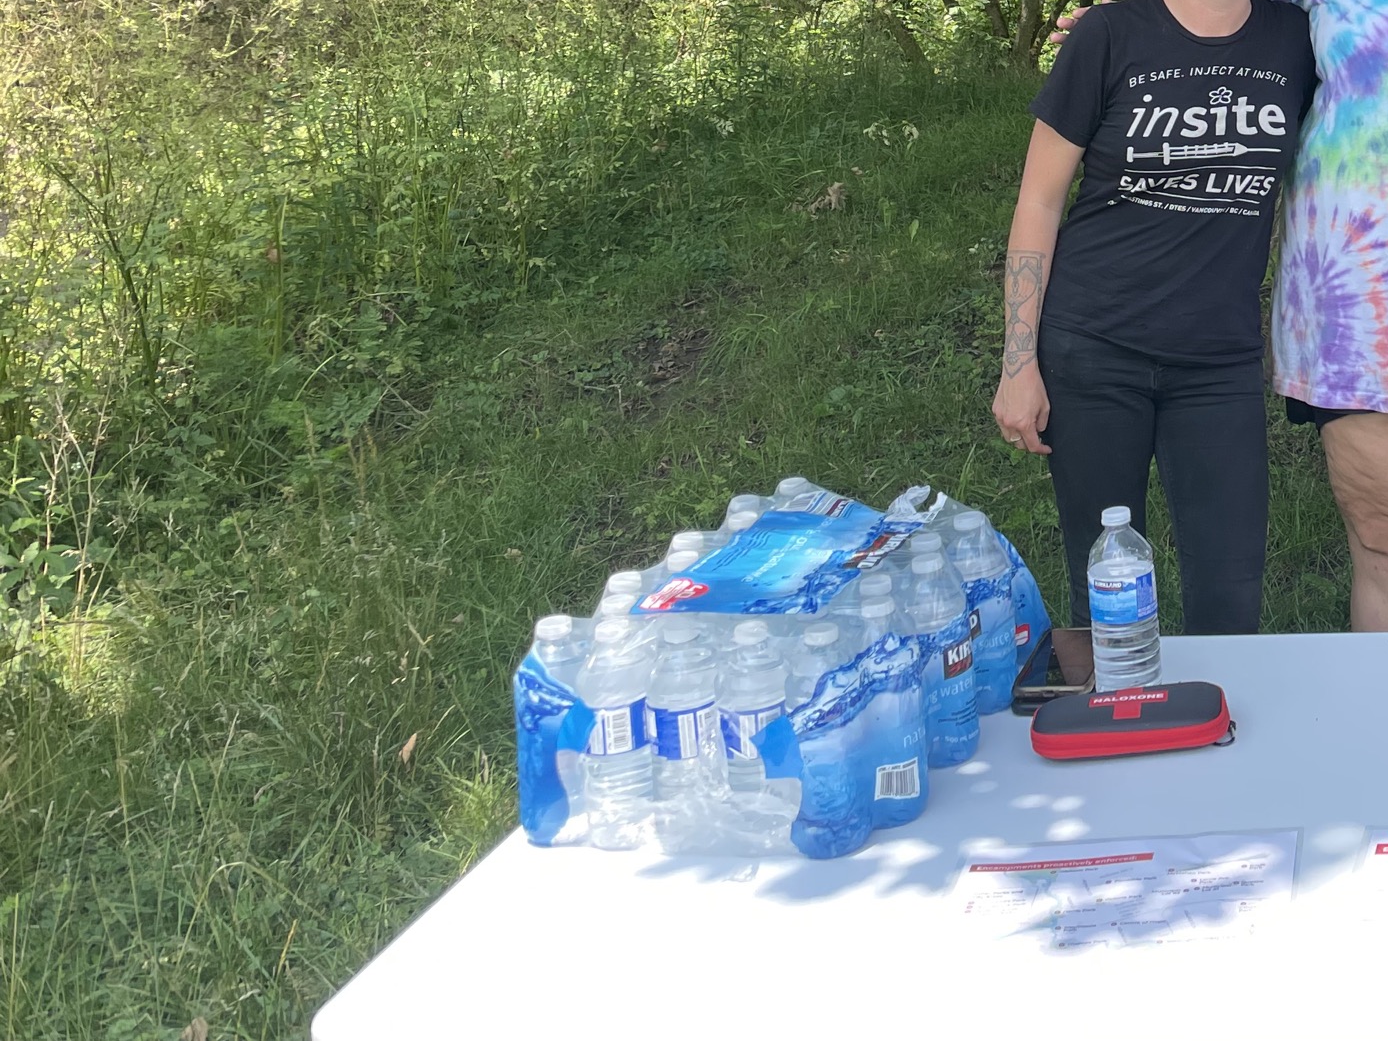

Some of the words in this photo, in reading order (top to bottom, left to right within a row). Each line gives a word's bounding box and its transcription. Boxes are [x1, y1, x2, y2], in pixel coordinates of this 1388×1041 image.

[1129, 74, 1146, 88] BE
[1150, 68, 1185, 82] SAFE.
[1189, 65, 1234, 77] INJECT
[1236, 67, 1251, 77] AT
[1252, 69, 1288, 87] INSITE
[1126, 91, 1287, 138] insite
[1118, 173, 1200, 193] SAVES
[1205, 173, 1276, 197] LIVES
[978, 631, 1010, 649] source
[1093, 693, 1165, 705] NALOXONE
[976, 861, 1042, 871] Encampments
[1043, 858, 1093, 870] proactively
[1095, 855, 1138, 865] enforced:
